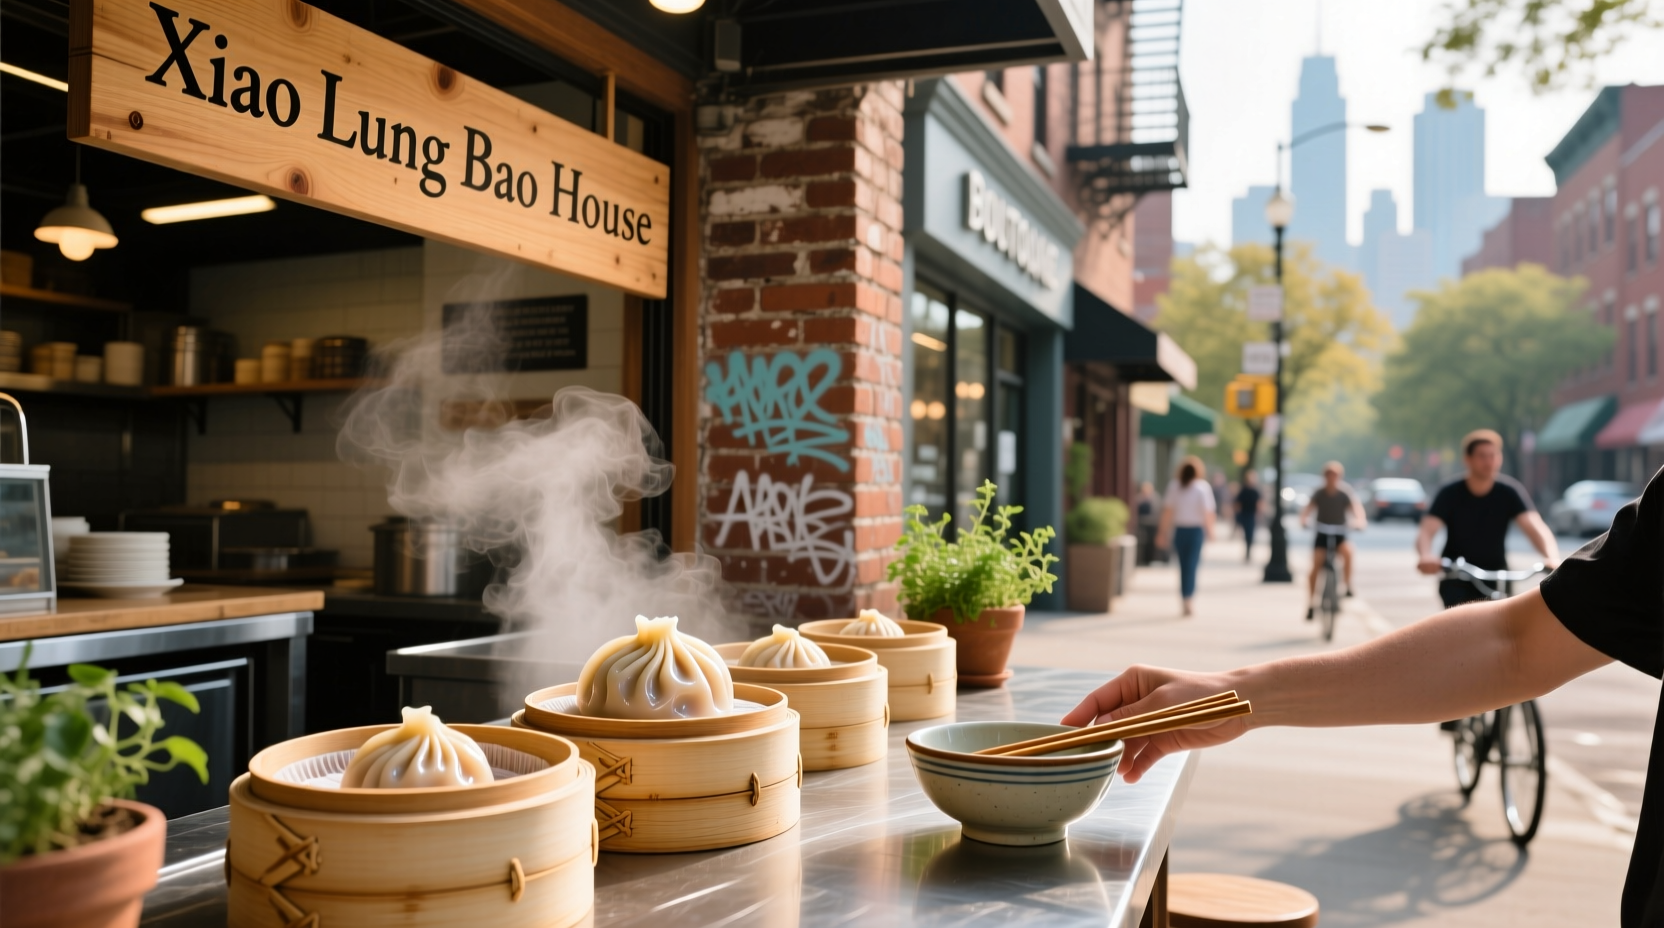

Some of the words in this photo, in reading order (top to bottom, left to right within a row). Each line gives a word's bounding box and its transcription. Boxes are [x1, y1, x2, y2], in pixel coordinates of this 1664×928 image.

[144, 1, 301, 128] Xiao
[317, 69, 450, 198] Lung
[460, 125, 538, 208] Bao
[549, 161, 653, 246] House
